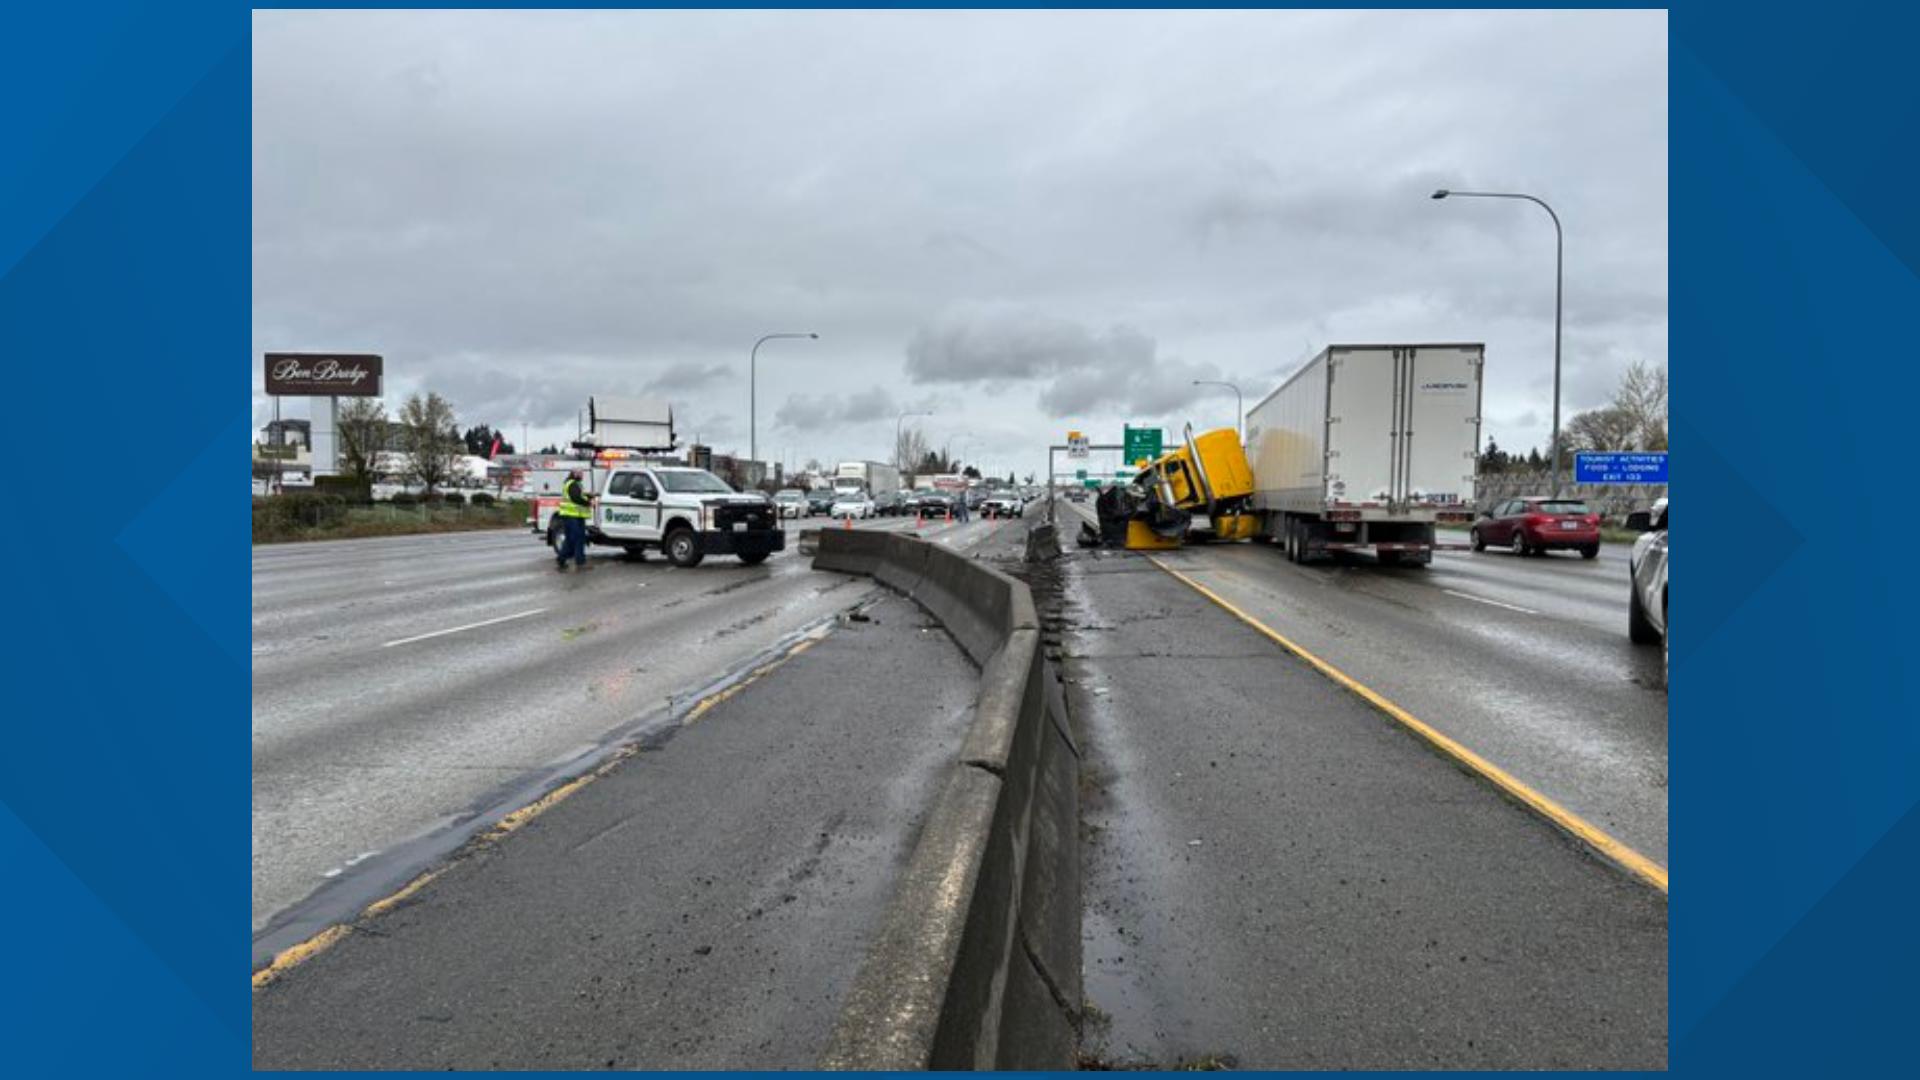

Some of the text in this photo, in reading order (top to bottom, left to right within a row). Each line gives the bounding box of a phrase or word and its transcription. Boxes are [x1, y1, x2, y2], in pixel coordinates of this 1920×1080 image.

[273, 359, 368, 385] Ben Bridge
[1580, 455, 1665, 464] TOURIST ACTIVITIES
[1584, 464, 1609, 472] FOOD
[1622, 464, 1660, 473] LODGING
[1603, 473, 1621, 481] EXIT
[614, 512, 641, 525] WSDOT
